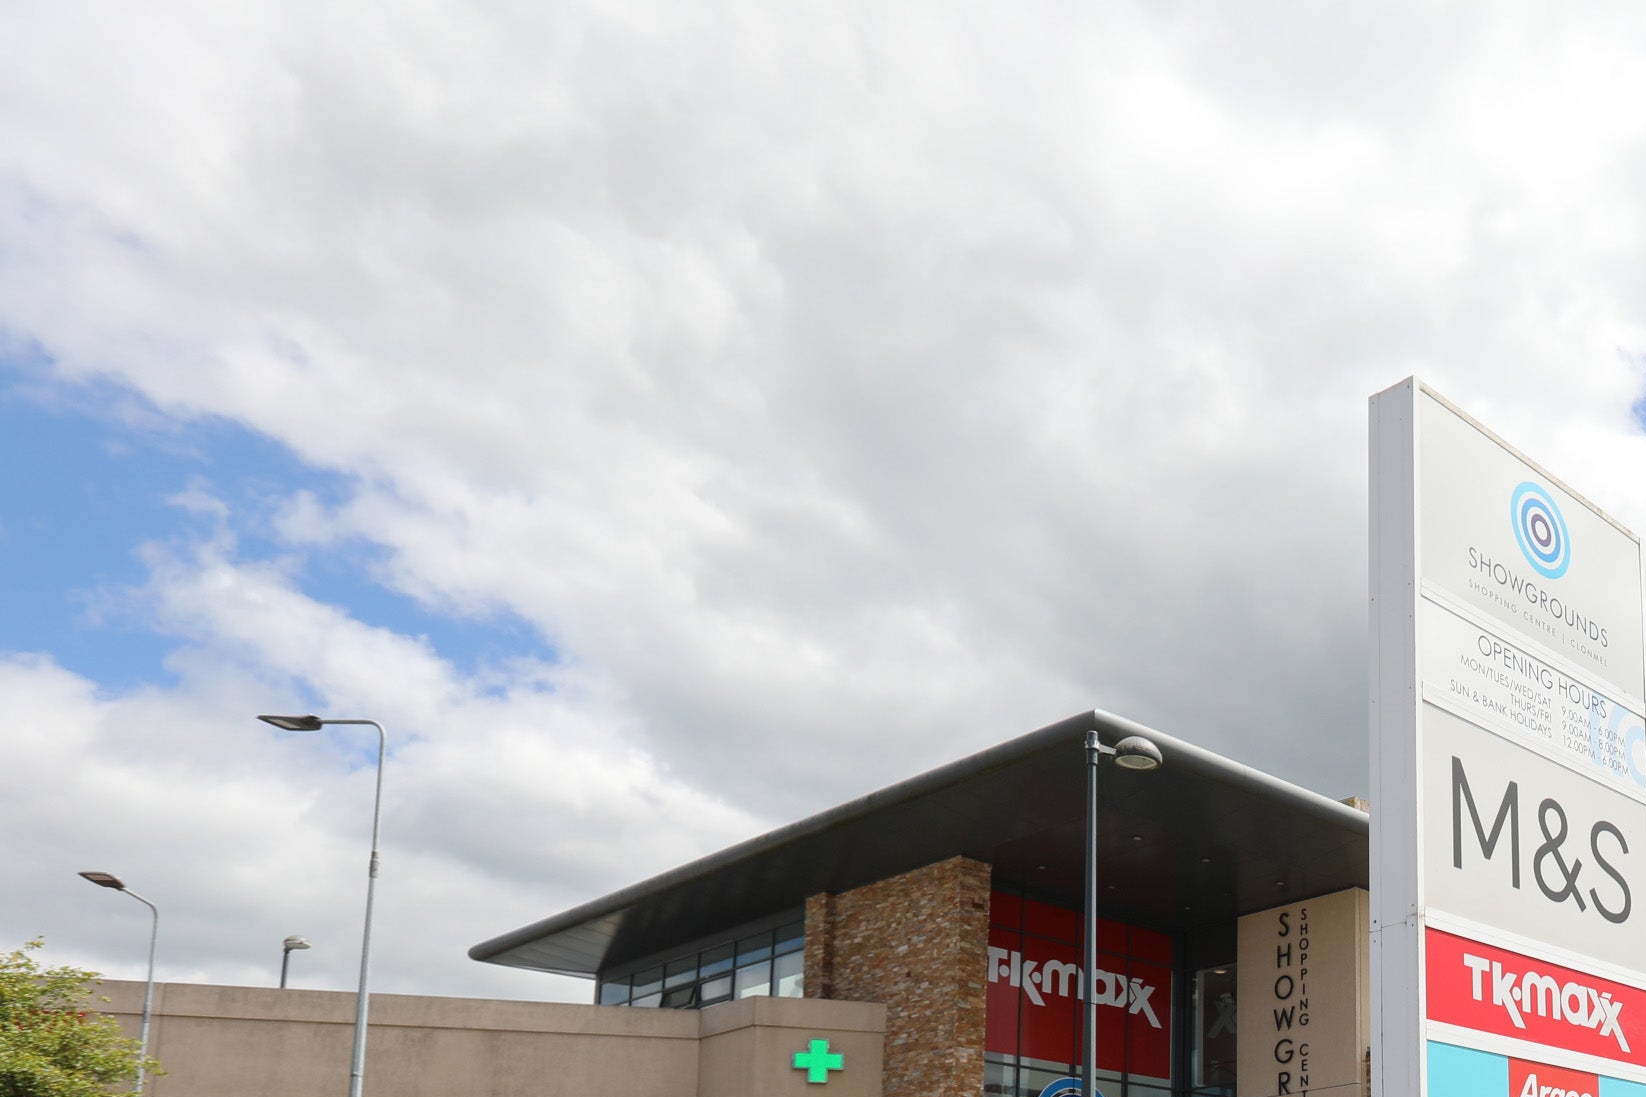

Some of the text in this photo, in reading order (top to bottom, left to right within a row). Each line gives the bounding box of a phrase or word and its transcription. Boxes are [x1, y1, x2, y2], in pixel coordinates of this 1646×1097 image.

[1468, 546, 1608, 648] SHOWGROUNDS
[1468, 578, 1518, 614] SHOPPING
[1523, 611, 1557, 637] CENTRE
[1570, 639, 1608, 667] CLONMEL
[1460, 654, 1552, 709] MON/TUES/WED/SAT
[1561, 705, 1592, 731] 9.00AM
[1598, 726, 1626, 747] 6.00PM
[1477, 635, 1607, 719] OPENING HOURS
[1450, 678, 1470, 697] SUN
[1472, 690, 1480, 704] &
[1482, 695, 1508, 717] BANK
[1510, 709, 1553, 739] HOLIDAYS
[1563, 735, 1596, 761] 12.00PM
[1602, 757, 1630, 777] 6.00PM
[1510, 693, 1552, 723] THURS/FRI
[1561, 720, 1592, 745] 9.00AM
[1598, 739, 1626, 761] 8.00PM
[1451, 755, 1632, 925] M&S
[1298, 908, 1310, 1026] SHOPPING
